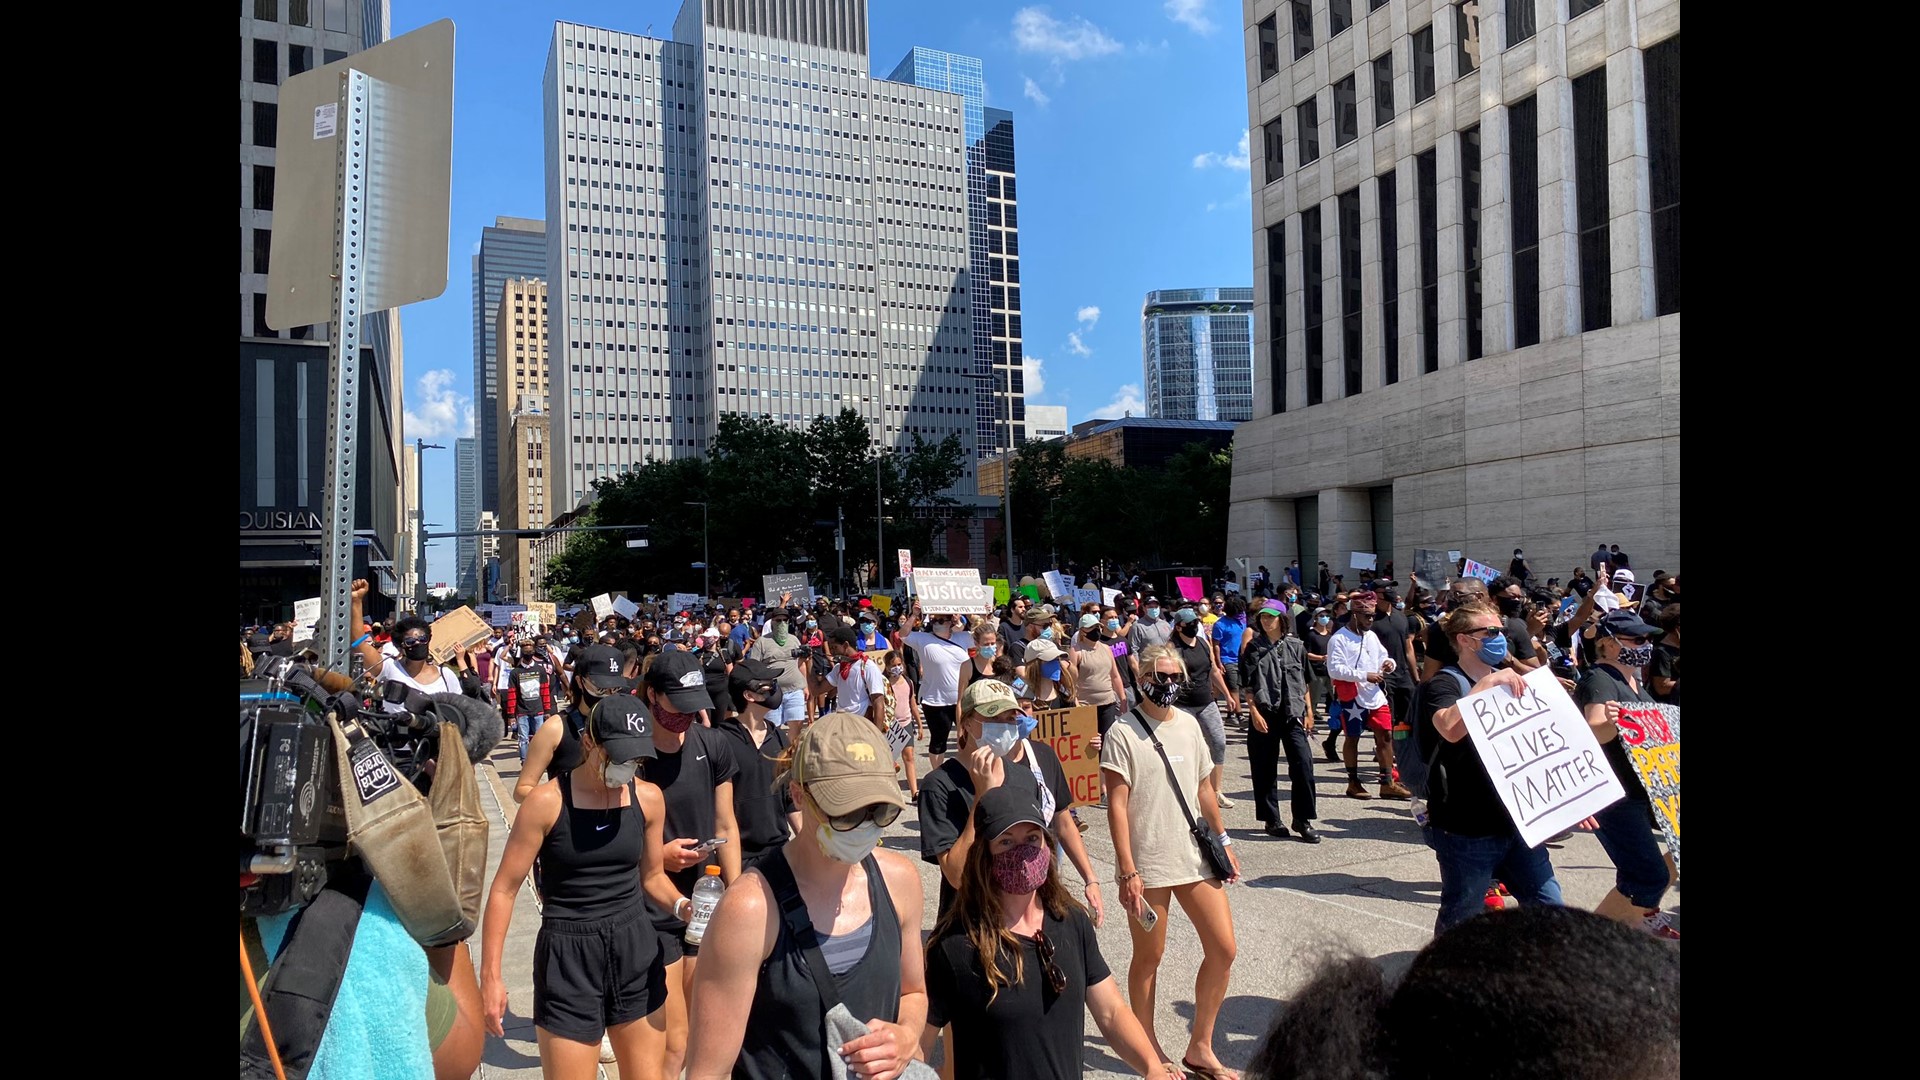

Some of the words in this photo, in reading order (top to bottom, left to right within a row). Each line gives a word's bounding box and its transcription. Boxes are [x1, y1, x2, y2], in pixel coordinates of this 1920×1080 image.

[915, 569, 933, 577] BLACK
[955, 569, 978, 577] MATTER
[609, 657, 619, 672] LA
[625, 713, 645, 733] KC
[1472, 686, 1548, 735] Black
[1492, 721, 1567, 771] LIVES
[1511, 749, 1604, 821] MATTER
